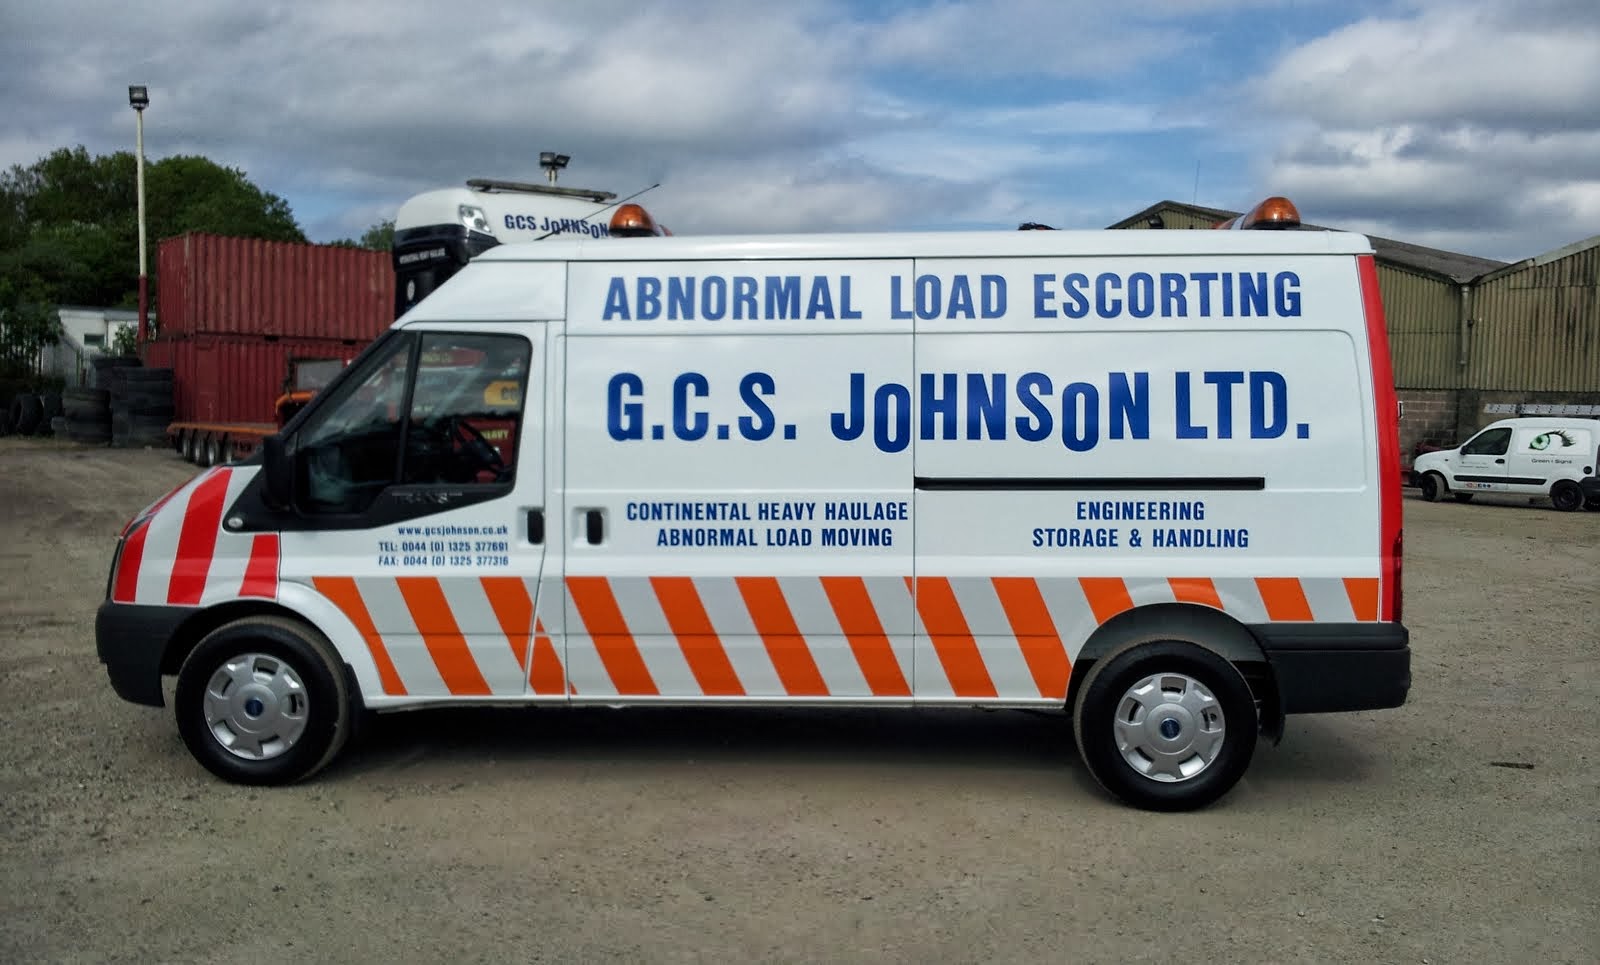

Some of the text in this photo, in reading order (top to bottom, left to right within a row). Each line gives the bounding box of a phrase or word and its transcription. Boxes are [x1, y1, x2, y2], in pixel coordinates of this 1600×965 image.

[504, 214, 537, 230] GCS
[602, 271, 1302, 321] ABNORMAL LOAD ESCORTING
[607, 372, 797, 441] G.C.S.
[1175, 371, 1310, 440] LTD.
[627, 502, 909, 521] CONTINENTAL HEAVY HAULAGE
[1076, 501, 1205, 520] ENGINEERING
[398, 526, 508, 536] www.gcsjohnson.co.uk
[657, 528, 892, 546] ABNORMAL LOAD MOVING
[1032, 528, 1249, 547] STORAGE & HANDLING
[379, 542, 398, 551] TEL:
[402, 542, 426, 551] 0044
[449, 542, 471, 551] 1325
[475, 542, 508, 551] 377691
[378, 556, 399, 566] FAX:
[403, 556, 427, 566] 0044
[450, 556, 472, 566] 1325
[476, 556, 509, 566] 377316
